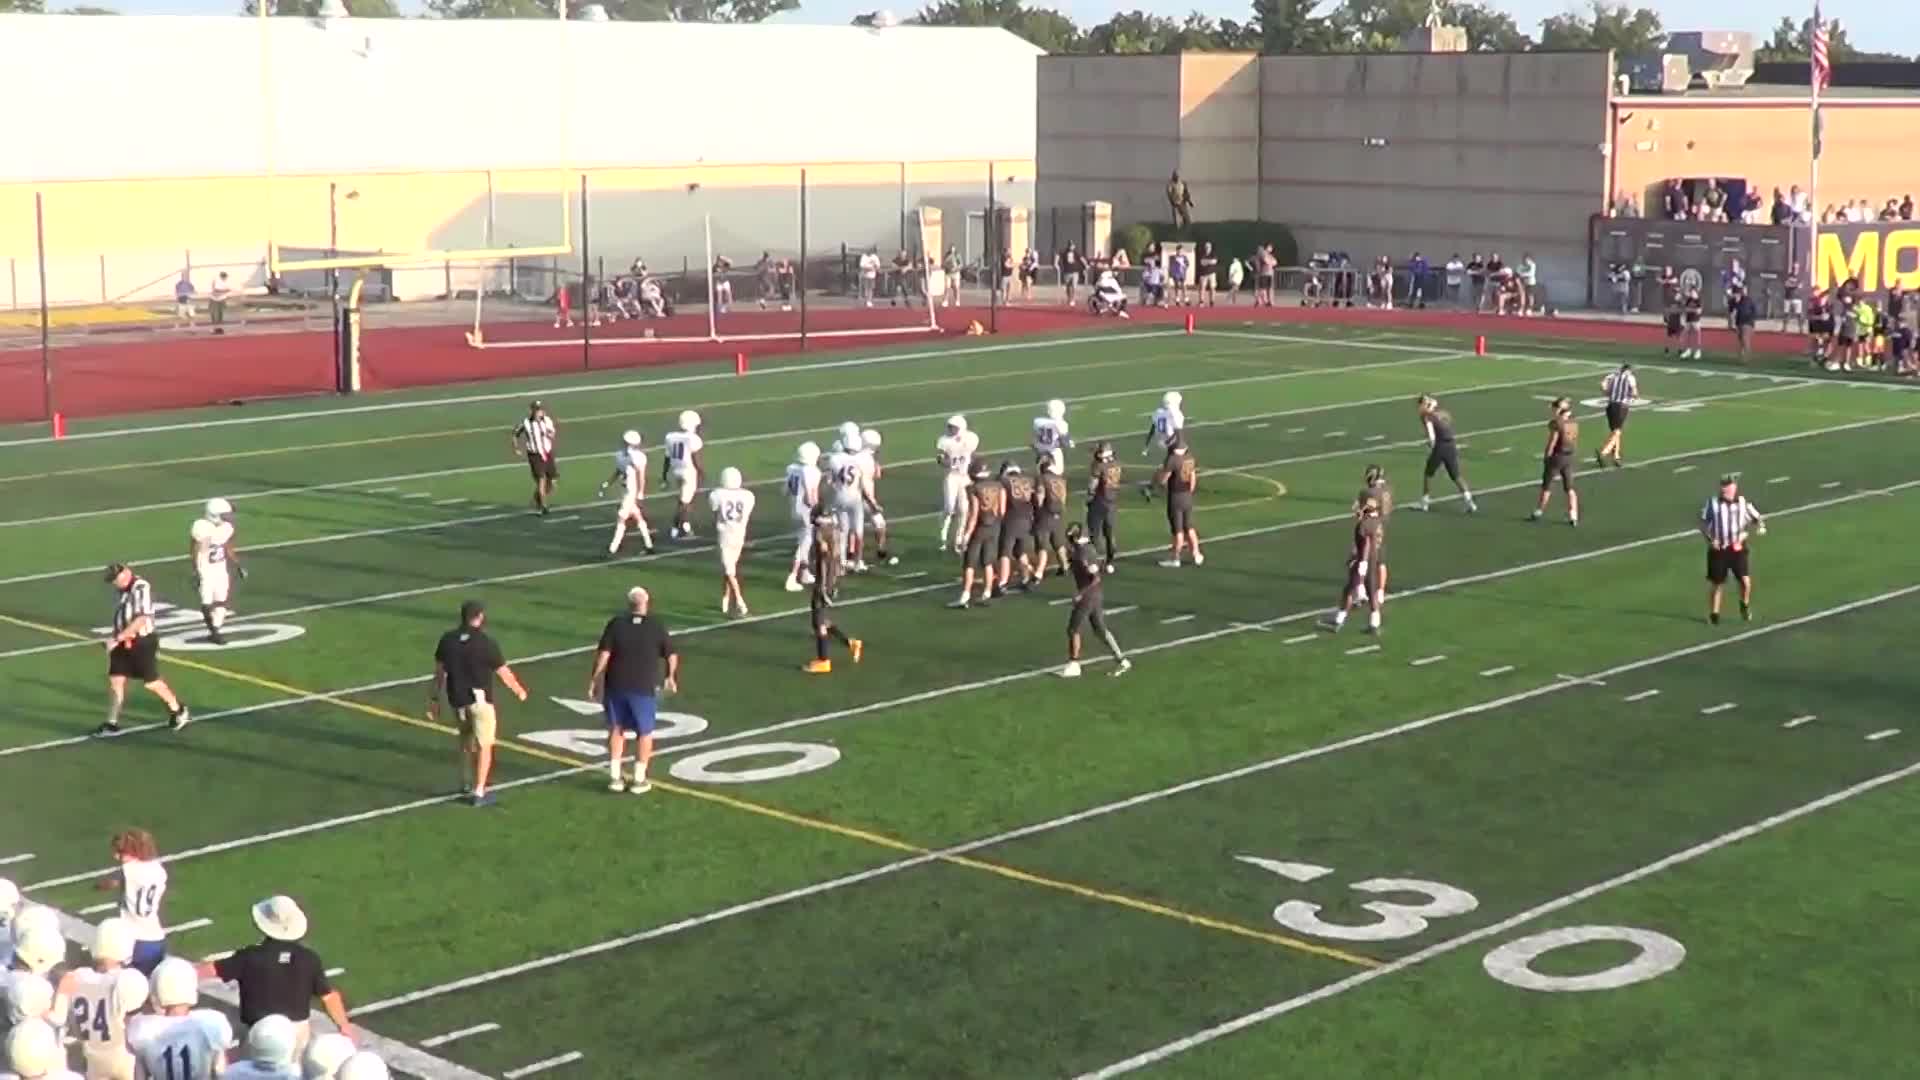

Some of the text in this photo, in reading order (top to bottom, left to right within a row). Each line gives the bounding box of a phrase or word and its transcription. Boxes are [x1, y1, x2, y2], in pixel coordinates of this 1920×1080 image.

[517, 712, 841, 783] 20
[135, 884, 157, 918] 19
[1272, 876, 1687, 992] 30
[71, 996, 110, 1041] 24
[160, 1043, 193, 1080] 11
